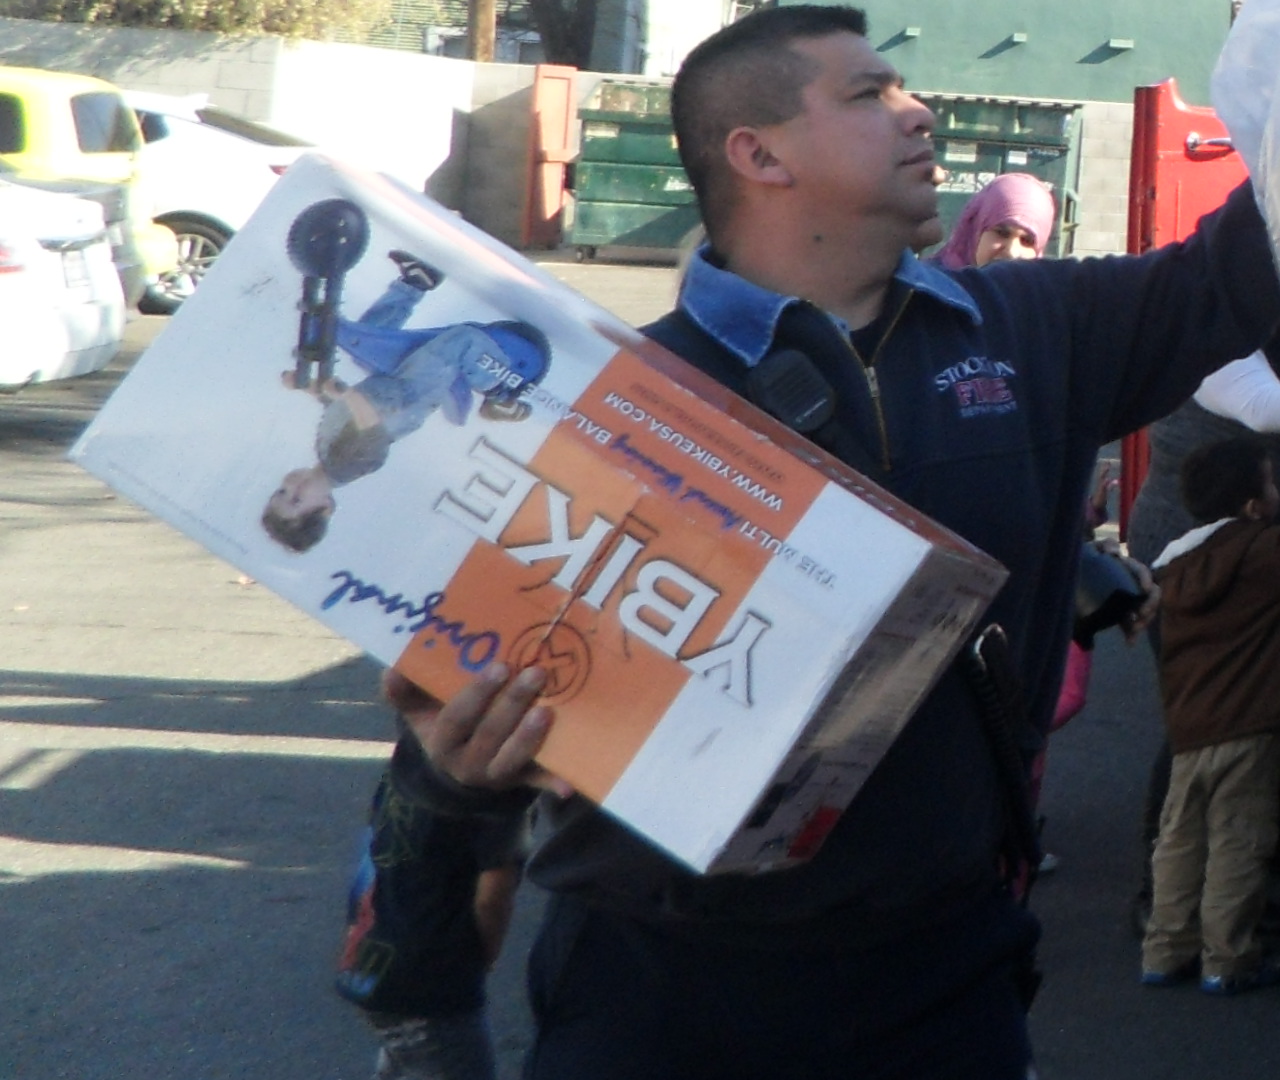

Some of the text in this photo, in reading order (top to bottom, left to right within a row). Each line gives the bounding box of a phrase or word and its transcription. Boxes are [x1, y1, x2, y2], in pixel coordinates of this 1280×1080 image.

[475, 350, 524, 390] BIKE
[522, 379, 612, 445] BALANCE
[603, 387, 785, 513] WWW.YBIKEUSA.COM
[433, 435, 773, 708] YBIKE
[738, 517, 798, 565] MULTI
[794, 554, 839, 592] THE
[321, 570, 500, 672] Original
